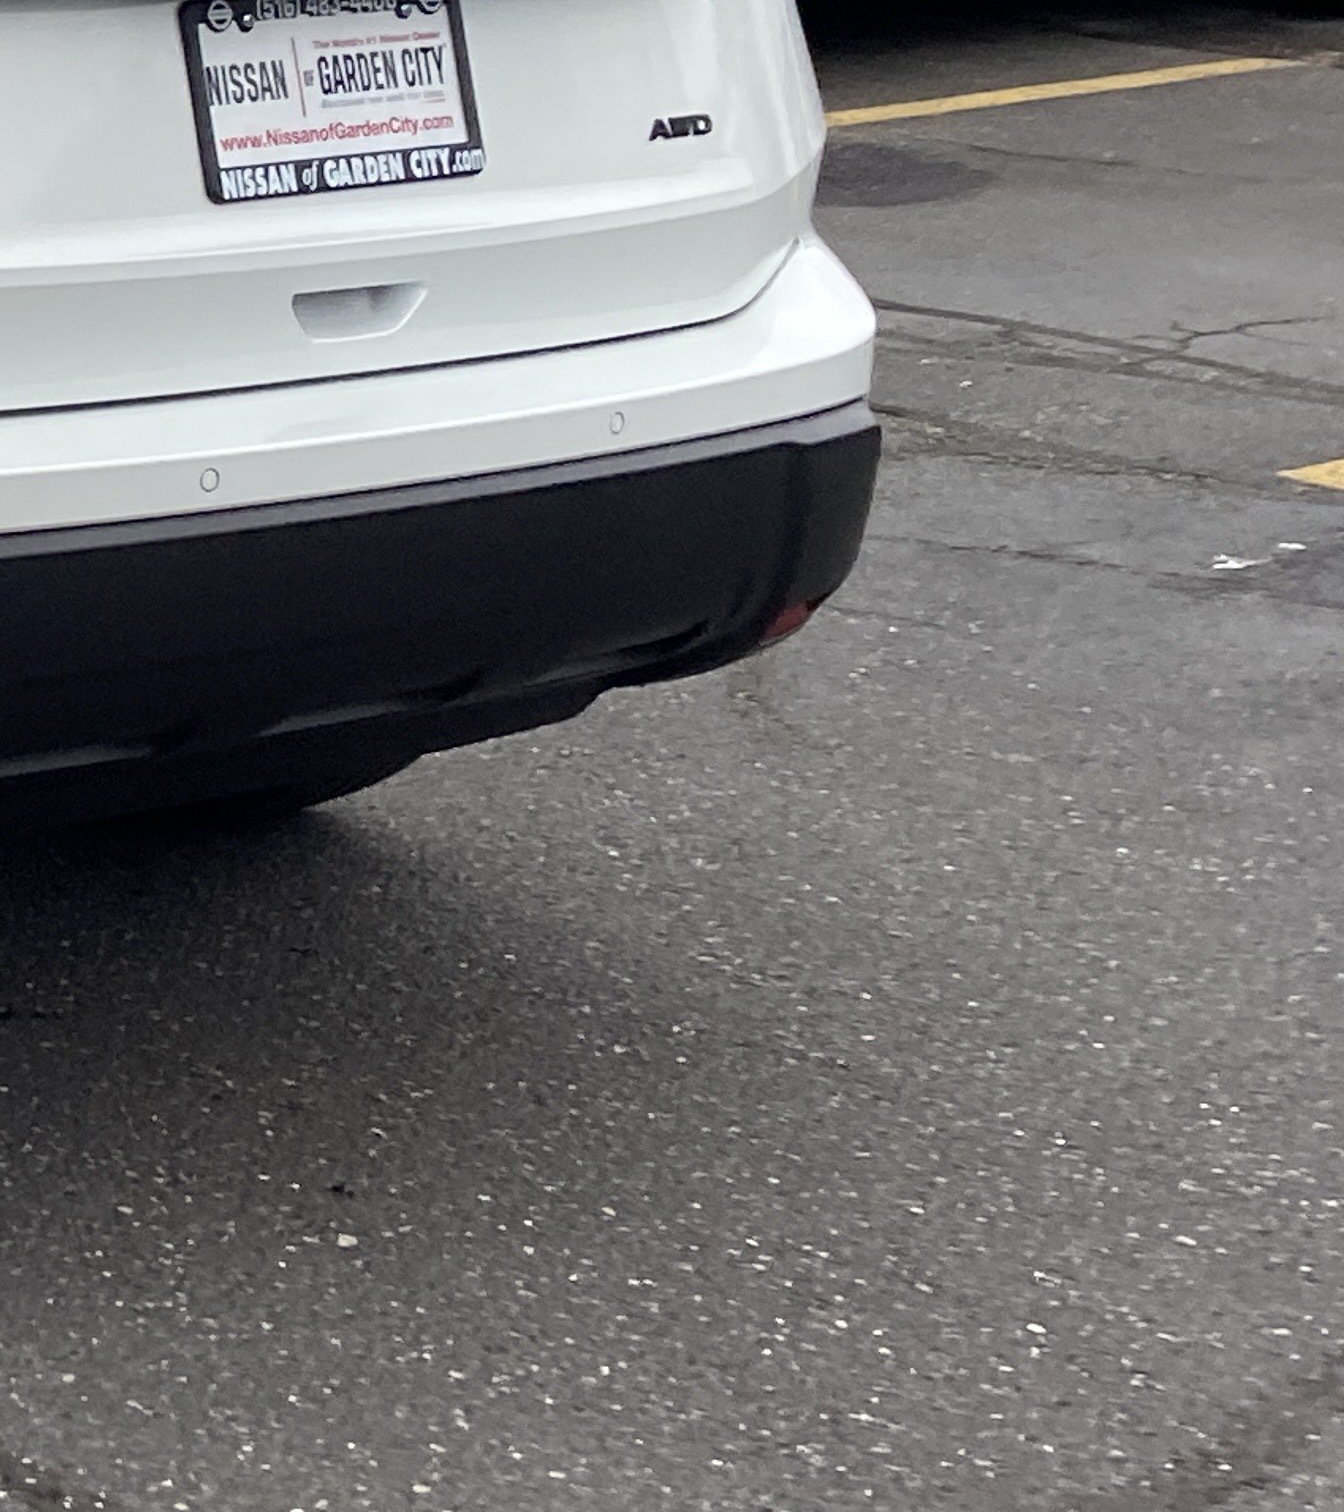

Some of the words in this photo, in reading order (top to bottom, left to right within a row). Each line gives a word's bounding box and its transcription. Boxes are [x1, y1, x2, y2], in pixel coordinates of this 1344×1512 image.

[205, 59, 289, 106] NISSAN
[317, 49, 399, 95] GARDEN
[401, 45, 445, 87] CITY
[219, 114, 455, 152] www.NissanofGardenCity.com
[220, 164, 299, 201] NISSAN
[301, 160, 320, 193] of
[323, 151, 405, 188] GARDEN
